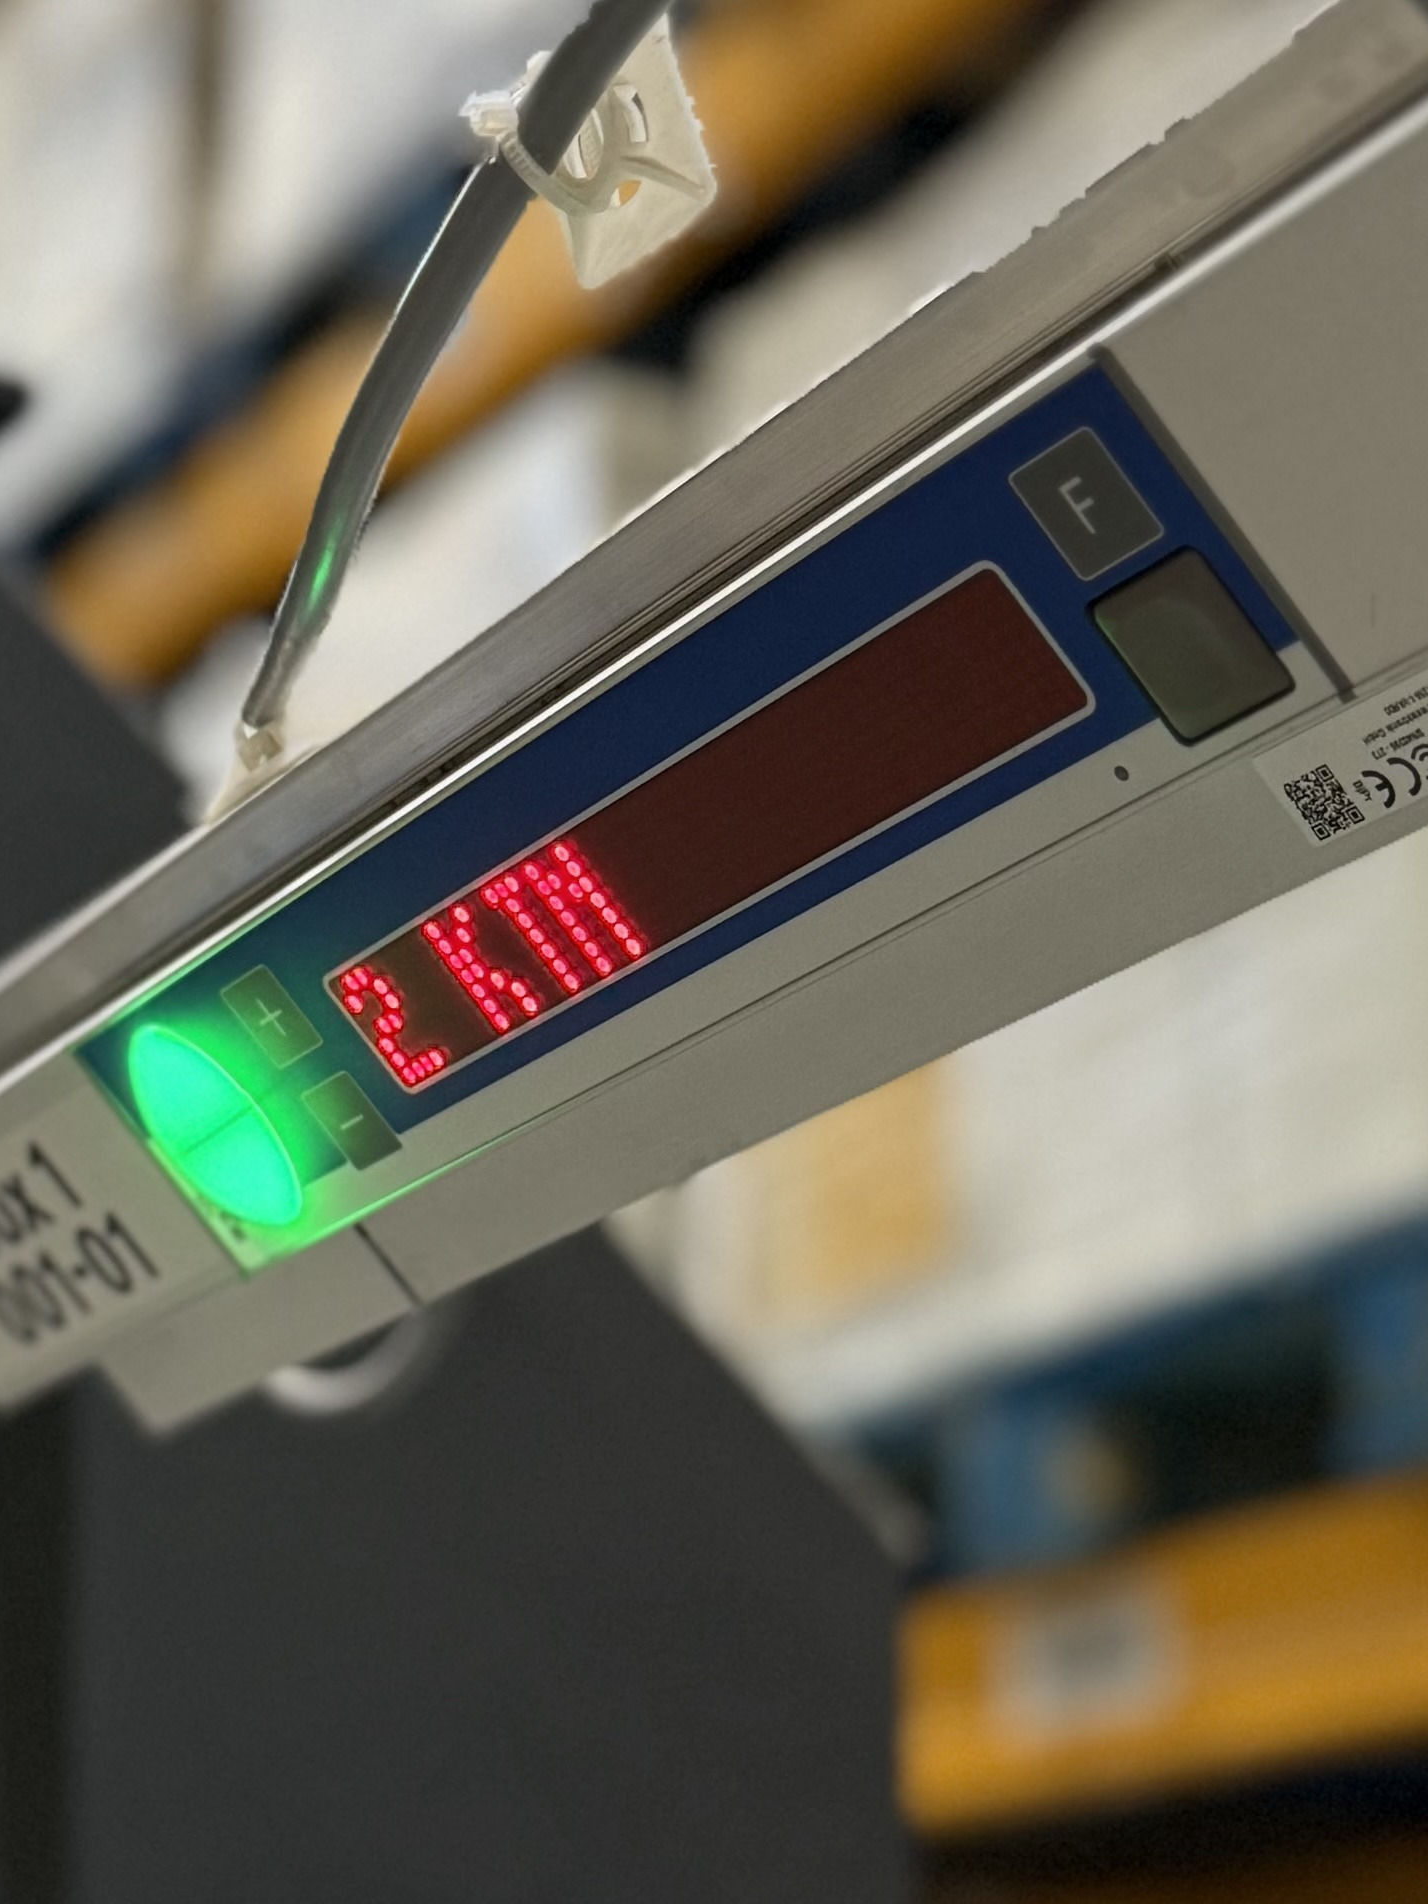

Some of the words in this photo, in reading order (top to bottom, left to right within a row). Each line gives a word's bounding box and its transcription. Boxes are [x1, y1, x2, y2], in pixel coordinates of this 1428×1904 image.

[1058, 475, 1096, 534] F
[339, 963, 448, 1086] 2
[28, 1142, 82, 1208] 1
